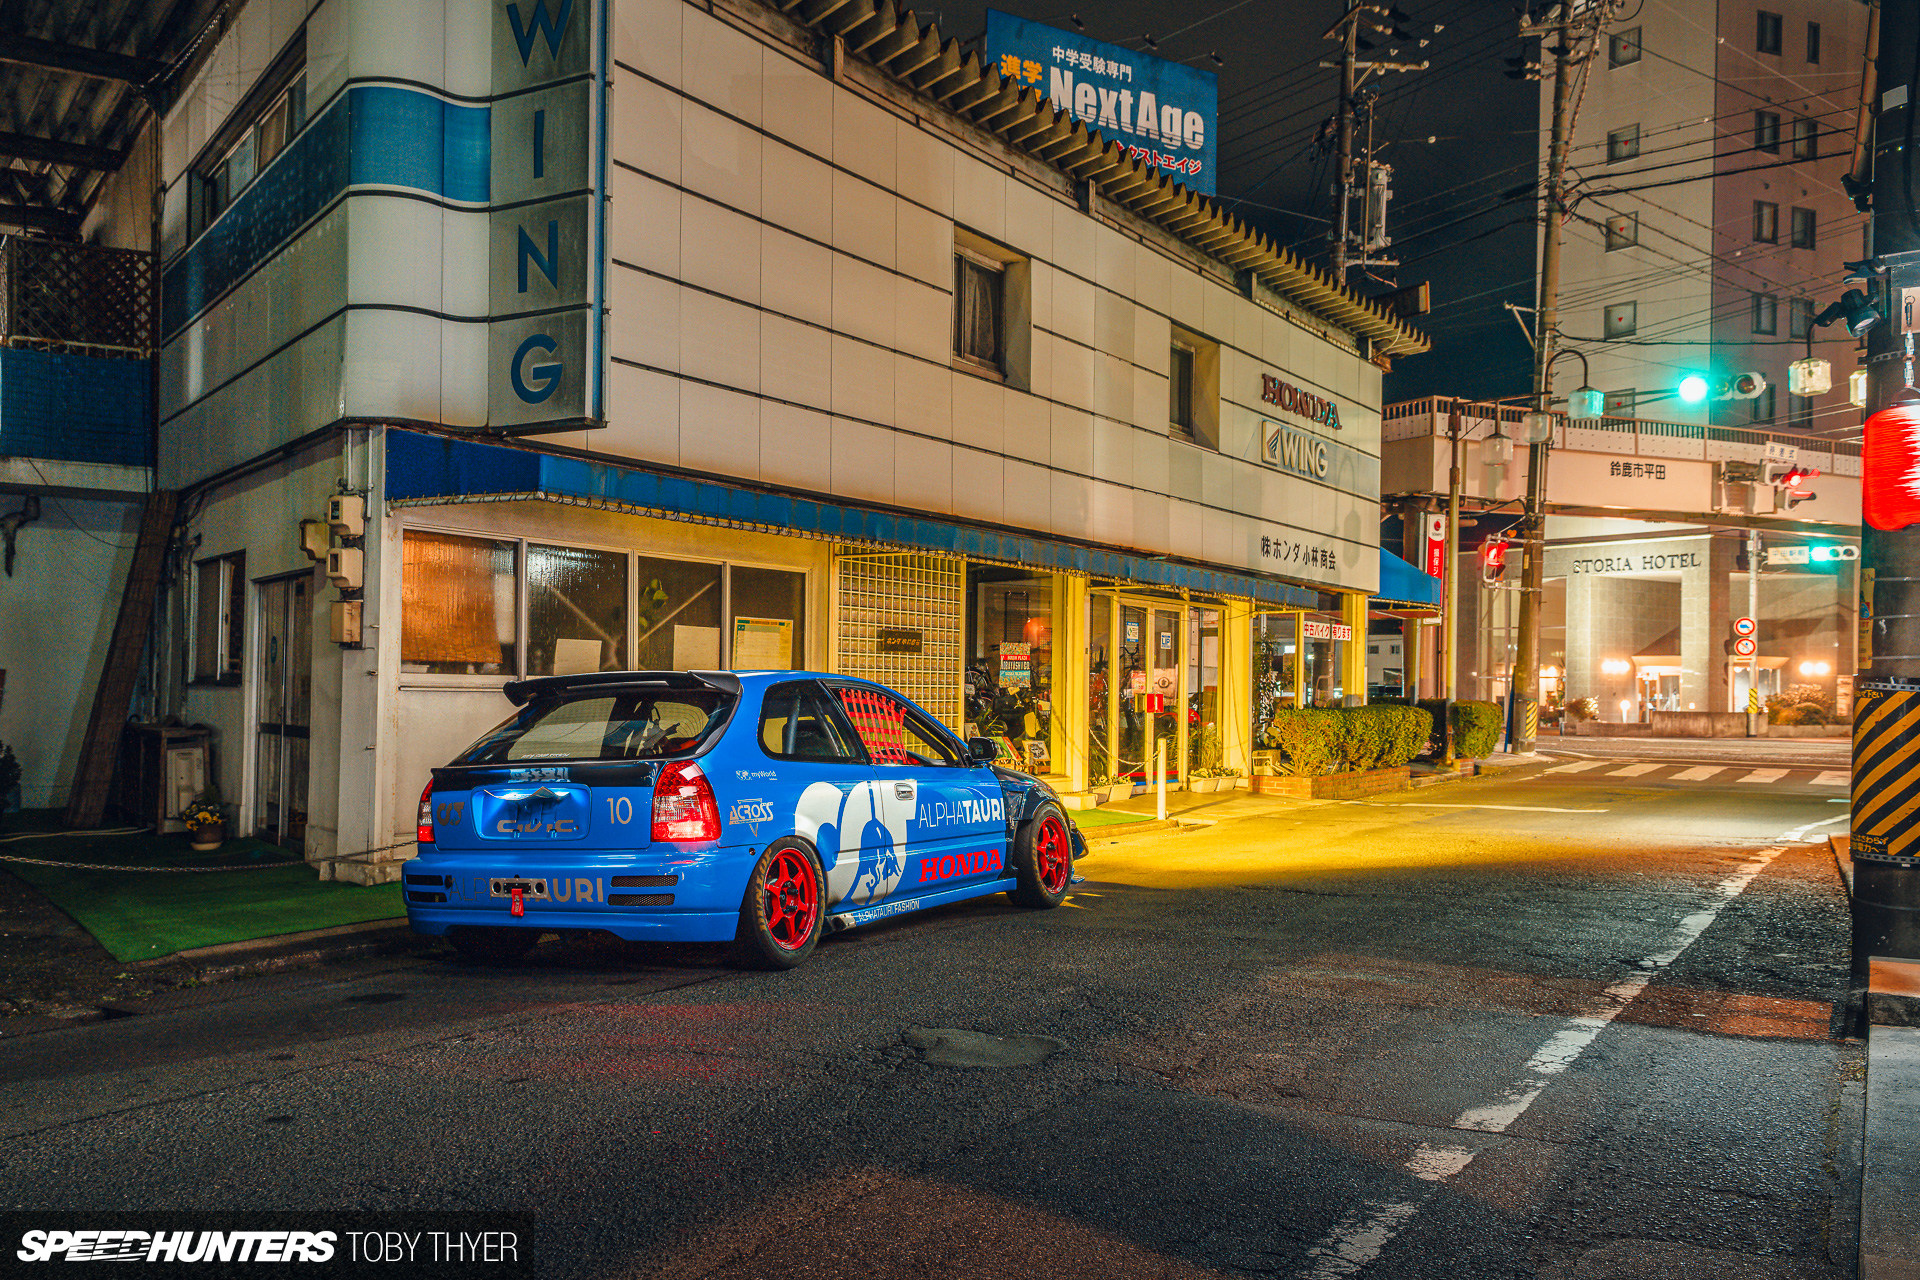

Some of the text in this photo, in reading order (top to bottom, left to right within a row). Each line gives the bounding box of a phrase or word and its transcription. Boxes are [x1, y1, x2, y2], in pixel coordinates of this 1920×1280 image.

[1000, 54, 1043, 84] 進学
[1052, 46, 1132, 82] 中学受験専門
[1116, 140, 1202, 176] クストエイジ
[1262, 373, 1342, 430] HONDA
[1281, 428, 1329, 479] WING
[1610, 460, 1666, 480] 鈴鹿市平田
[1642, 553, 1701, 570] HOTEL
[1304, 622, 1330, 638] 中古バイク
[606, 797, 633, 825] 10
[729, 801, 774, 823] ACROSS
[919, 797, 1005, 829] ALPHATAURI
[919, 848, 1004, 883] HONDA
